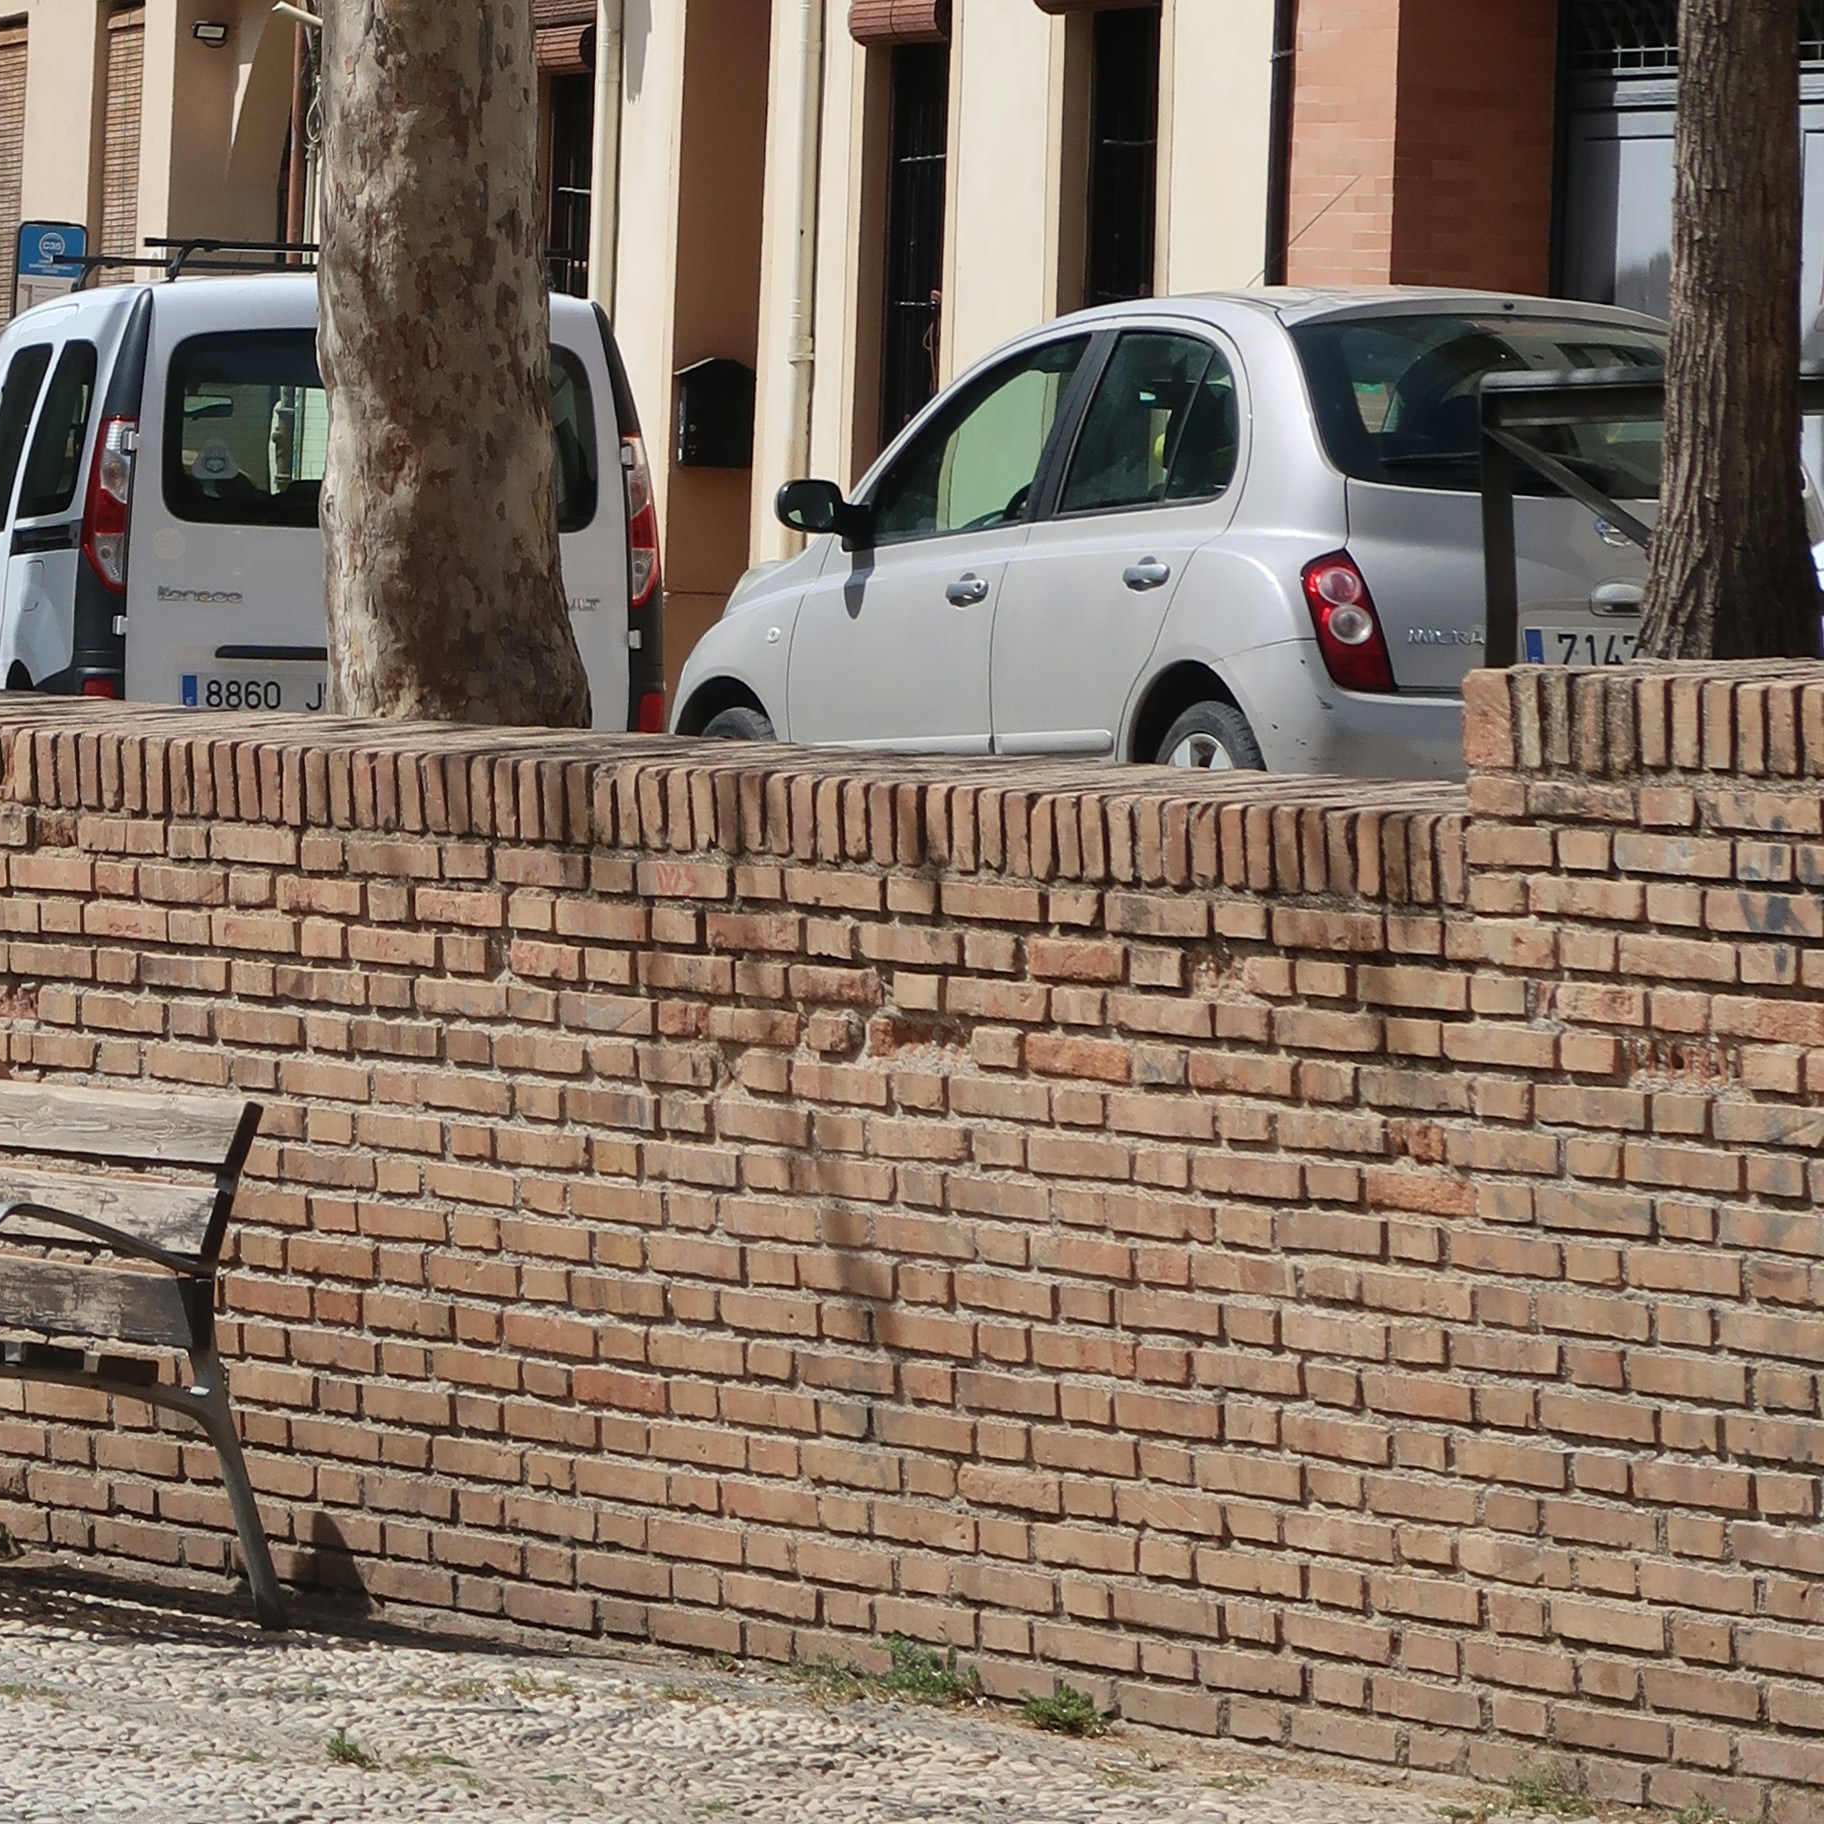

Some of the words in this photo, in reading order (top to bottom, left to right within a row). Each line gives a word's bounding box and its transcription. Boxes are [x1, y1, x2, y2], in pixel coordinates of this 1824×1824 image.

[1407, 626, 1485, 645] MICRA
[206, 680, 281, 710] 8860
[305, 681, 327, 711] J
